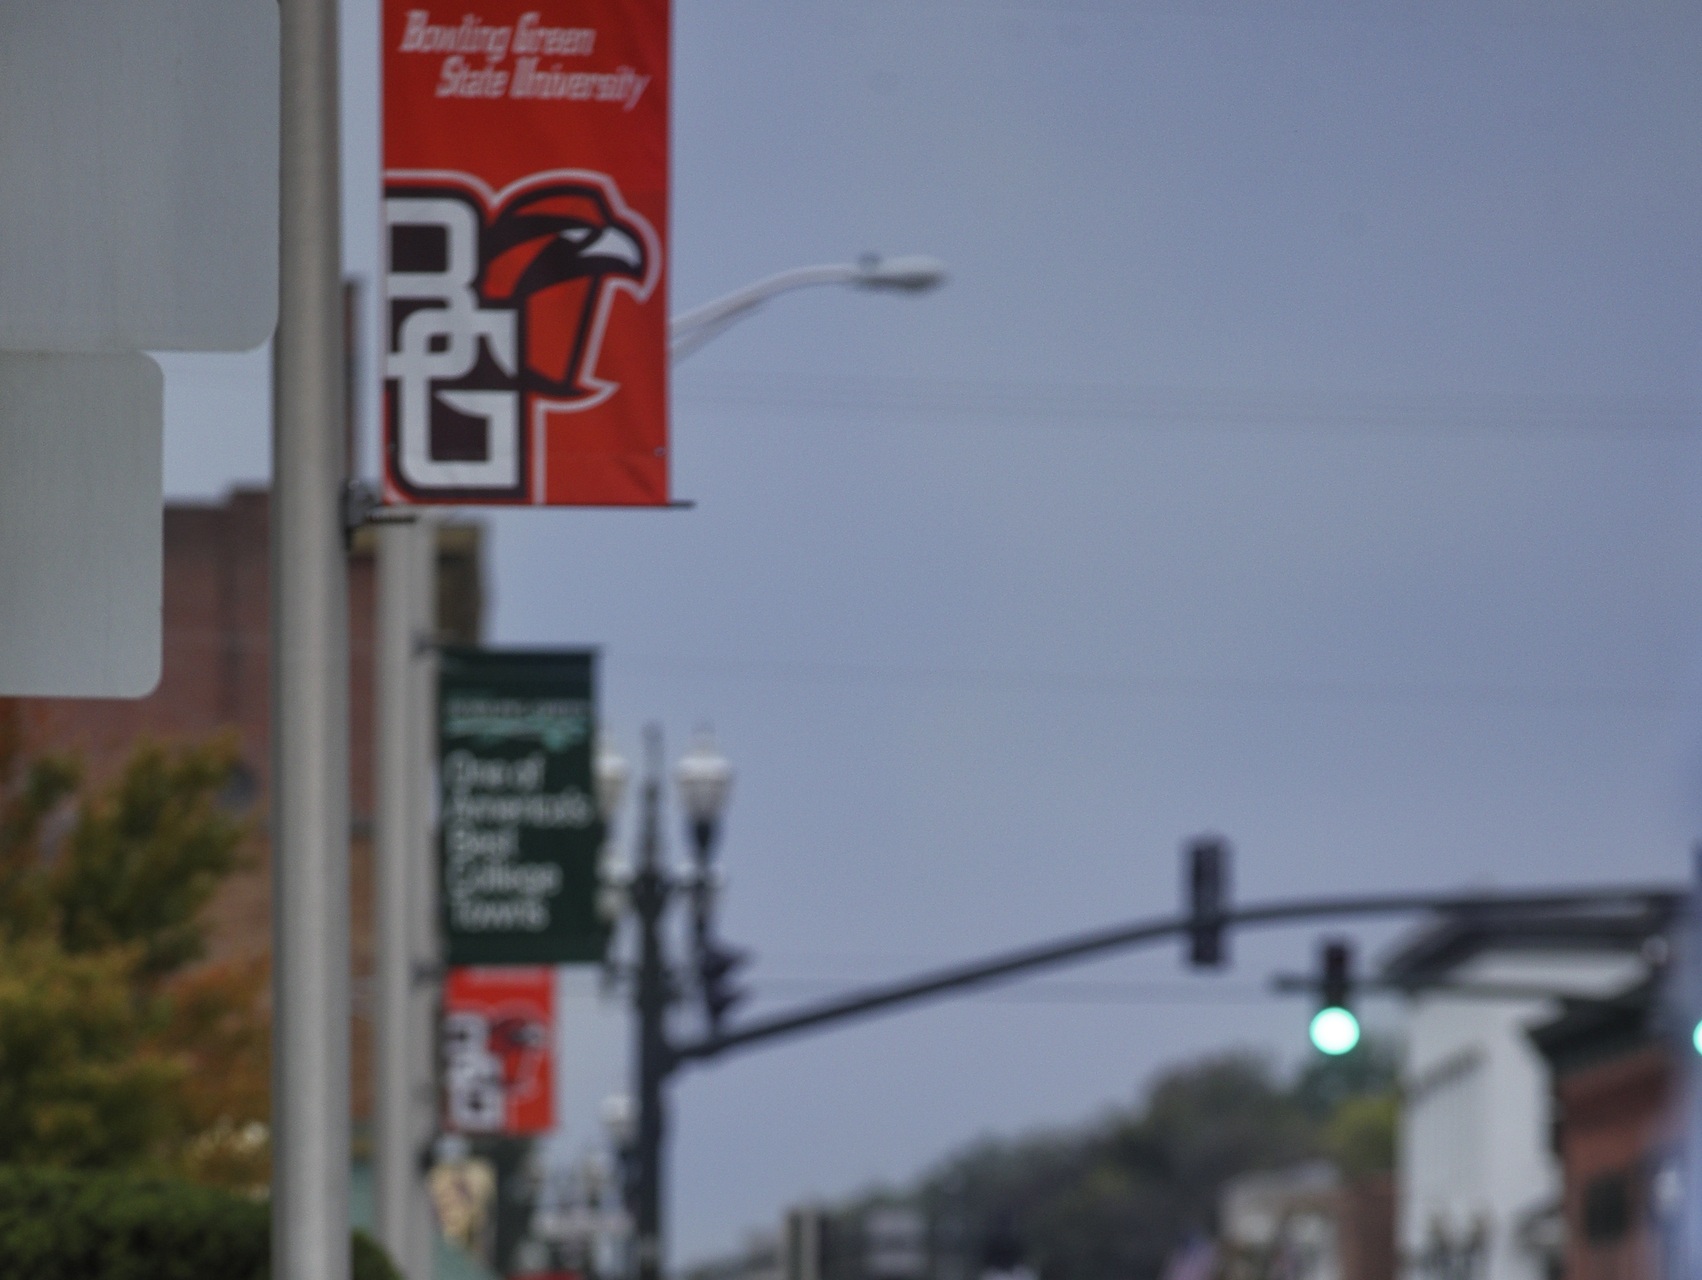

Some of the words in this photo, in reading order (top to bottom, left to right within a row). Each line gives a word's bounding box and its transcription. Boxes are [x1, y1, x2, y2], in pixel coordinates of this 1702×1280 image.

[400, 9, 511, 63] Bowling
[511, 11, 597, 56] Green
[434, 55, 509, 98] State
[510, 56, 650, 112] University
